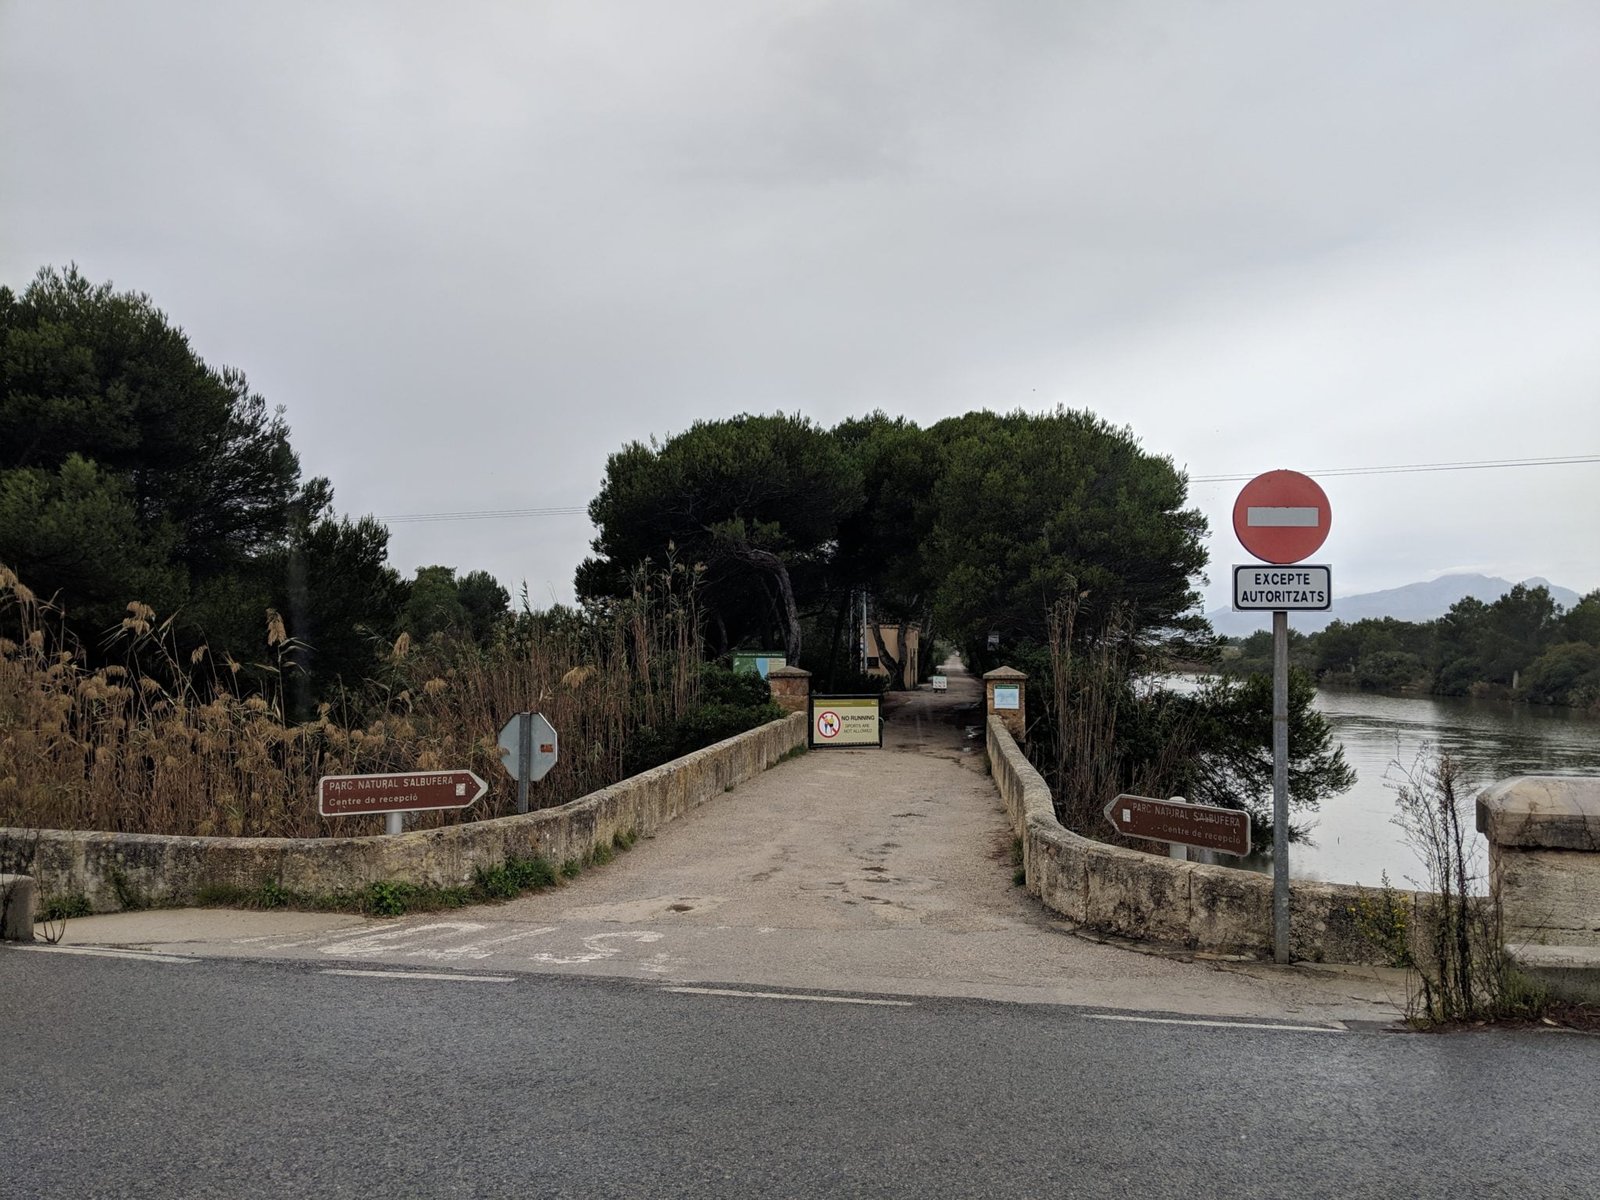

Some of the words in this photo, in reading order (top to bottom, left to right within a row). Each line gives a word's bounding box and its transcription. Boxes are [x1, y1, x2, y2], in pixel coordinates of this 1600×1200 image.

[1254, 573, 1310, 585] EXCEPTE
[1241, 591, 1325, 603] AUTORITZATS
[329, 781, 353, 791] PARC
[358, 779, 399, 790] NATURAL
[403, 776, 453, 788] S'ALBUFERA
[329, 797, 361, 807] Centre
[365, 796, 376, 804] de
[1132, 802, 1151, 813] PARC
[1155, 805, 1189, 820] NATURAL
[1162, 824, 1189, 836] Centre
[1192, 828, 1202, 838] de
